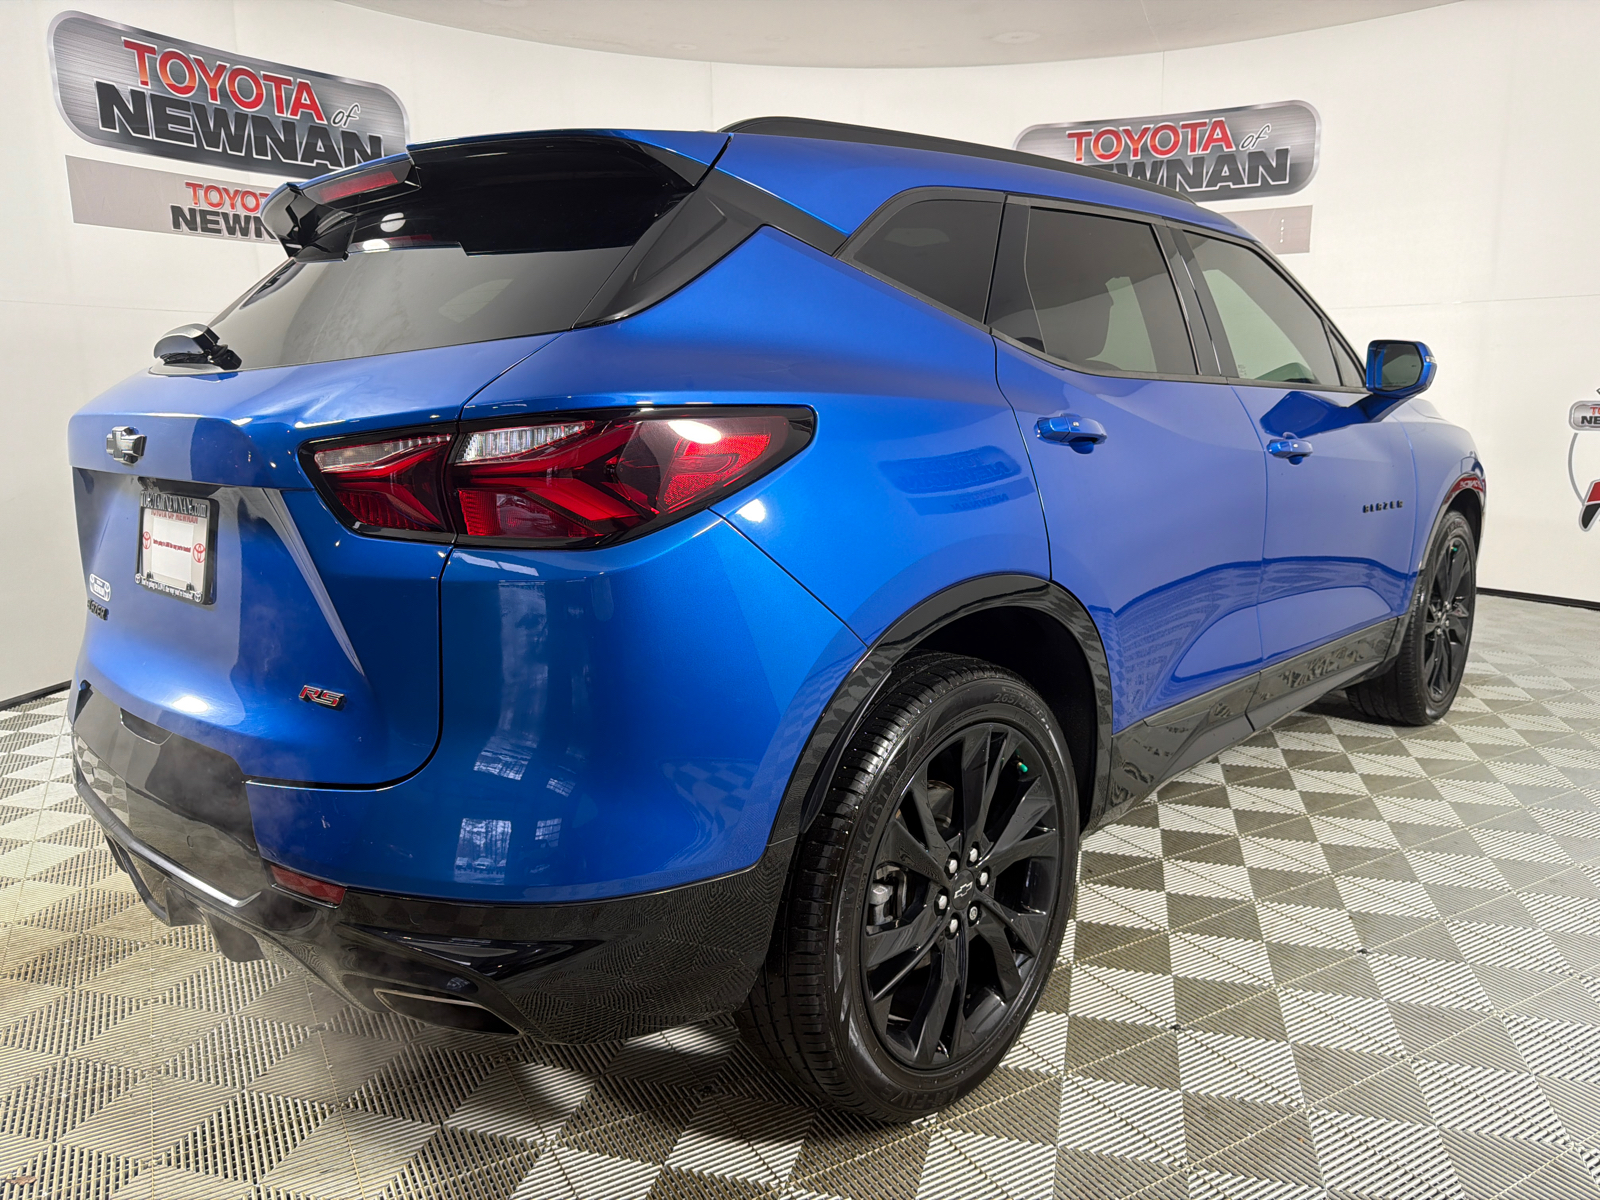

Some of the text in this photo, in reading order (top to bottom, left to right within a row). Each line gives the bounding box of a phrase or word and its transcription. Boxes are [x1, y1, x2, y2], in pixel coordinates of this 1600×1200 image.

[122, 38, 360, 128] TOYOTA of
[95, 80, 384, 168] NEWNAN
[1066, 118, 1271, 162] TOYOTA of
[1092, 147, 1291, 192] WNAN
[185, 181, 271, 213] TOYO
[170, 205, 277, 240] NEWN
[299, 685, 345, 707] RS
